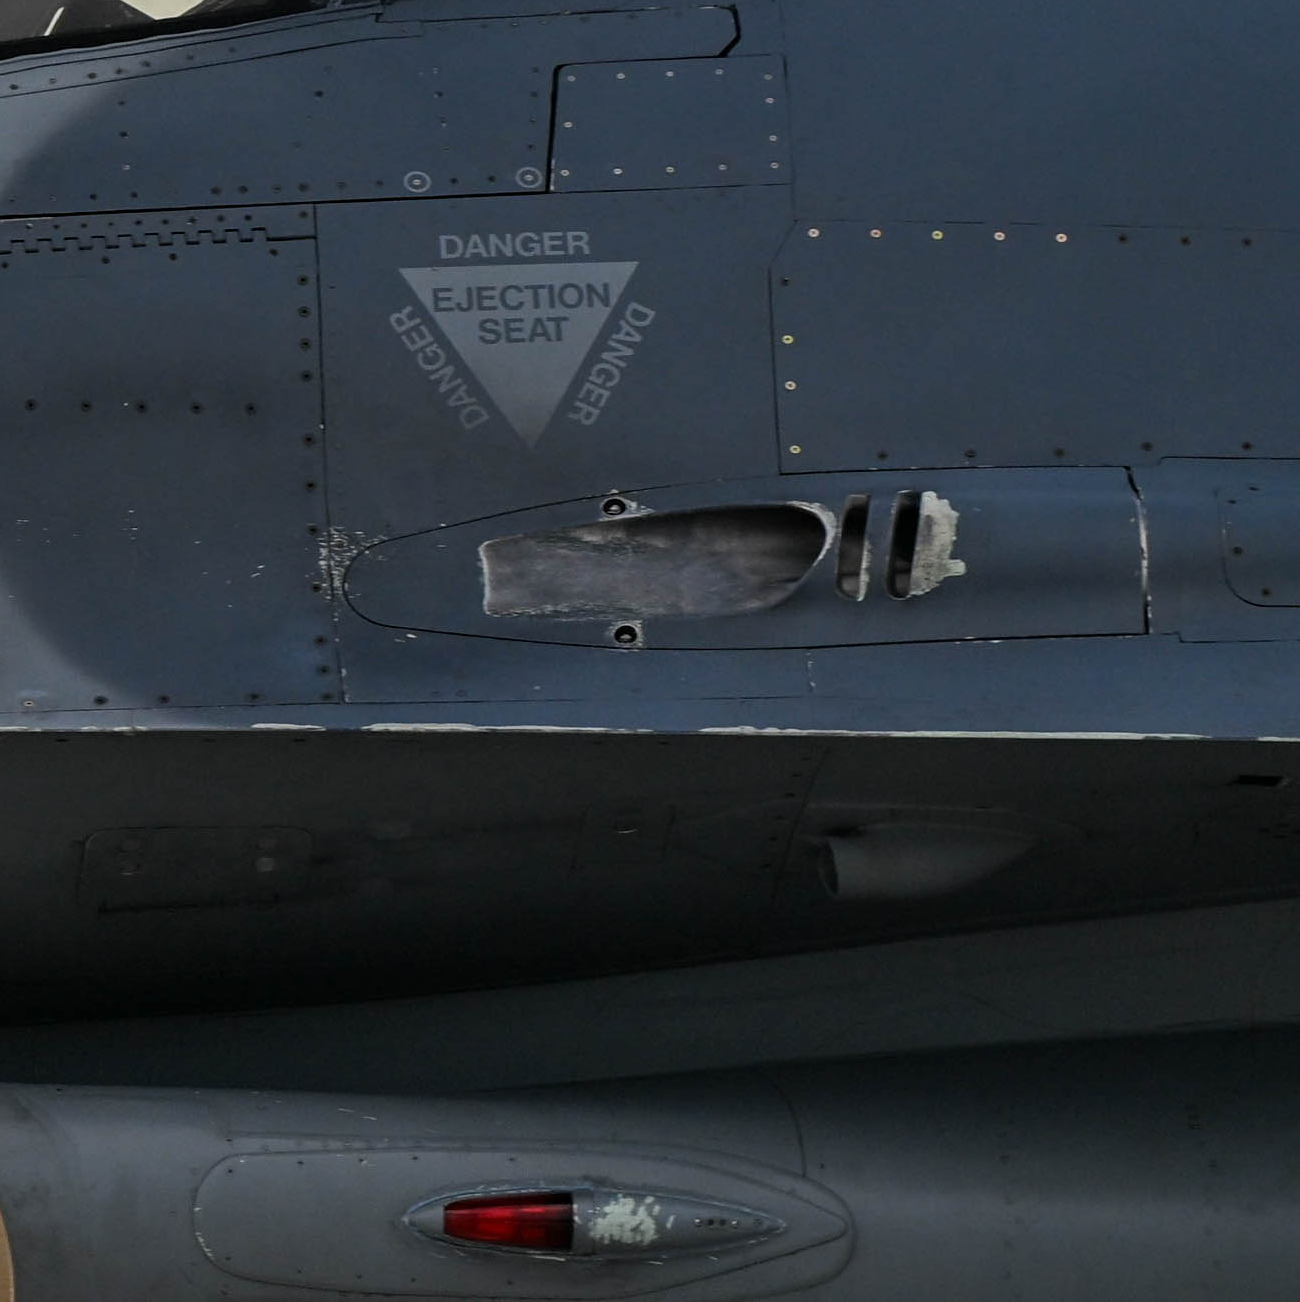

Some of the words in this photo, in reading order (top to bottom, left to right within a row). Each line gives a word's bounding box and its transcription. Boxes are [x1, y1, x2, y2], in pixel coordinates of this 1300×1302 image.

[438, 231, 592, 260] DANGER
[432, 283, 611, 313] EJECTION
[478, 316, 569, 345] SEAT
[389, 305, 490, 430] DANGER
[568, 301, 656, 426] DANGER
